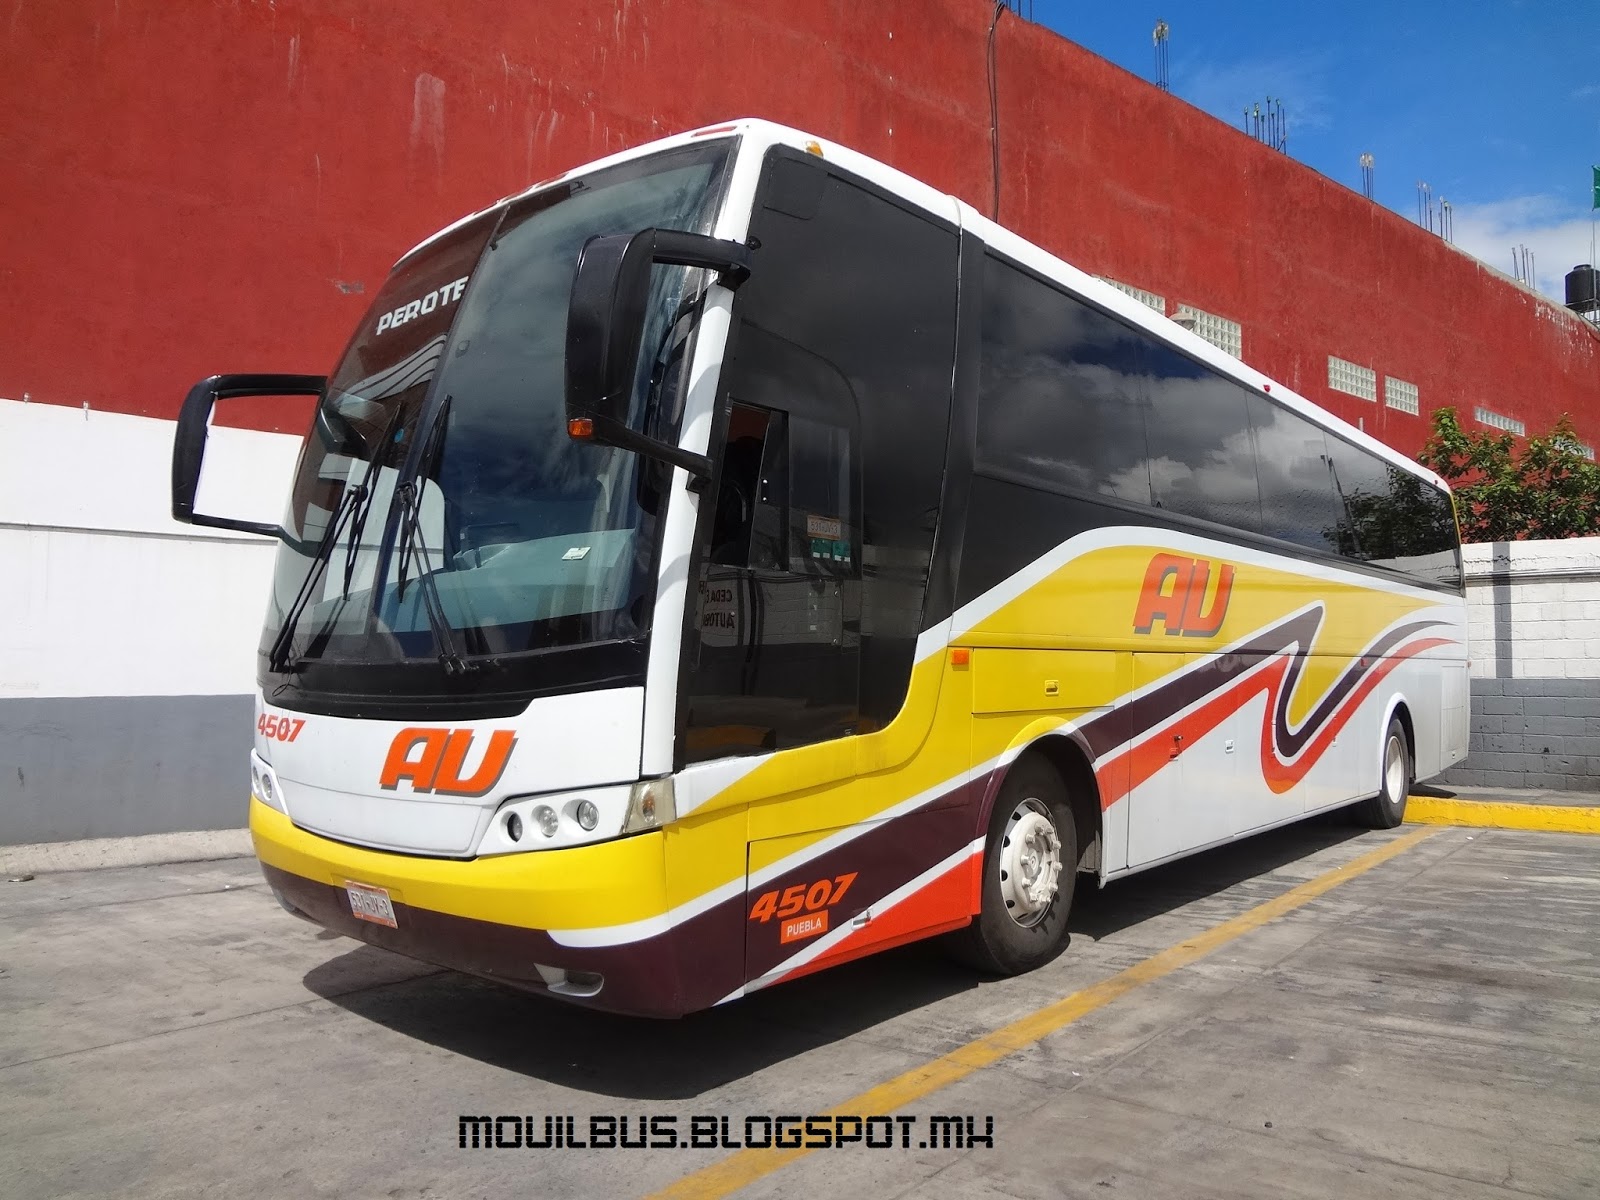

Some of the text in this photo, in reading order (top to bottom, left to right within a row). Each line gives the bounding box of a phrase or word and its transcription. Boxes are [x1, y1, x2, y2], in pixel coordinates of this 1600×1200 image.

[1132, 552, 1235, 637] AU
[257, 713, 306, 742] 4507
[379, 727, 518, 797] AU
[749, 872, 858, 922] 4507
[787, 917, 822, 937] PUEBLA
